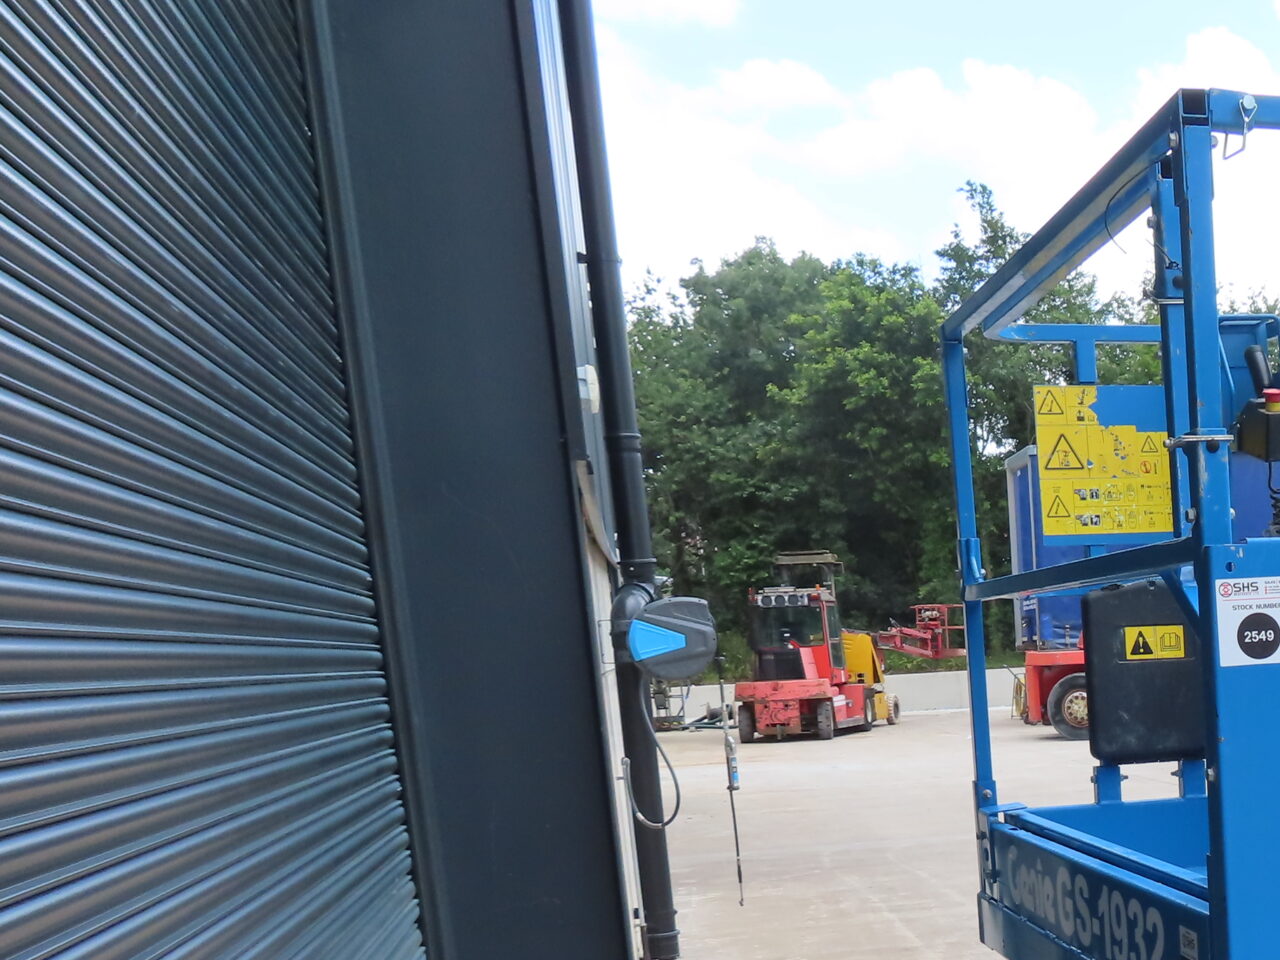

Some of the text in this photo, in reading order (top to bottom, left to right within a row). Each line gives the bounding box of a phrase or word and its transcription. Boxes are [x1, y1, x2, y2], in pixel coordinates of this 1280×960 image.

[1233, 582, 1259, 593] SHS
[1243, 629, 1275, 643] 2549
[1008, 845, 1056, 924] Genie
